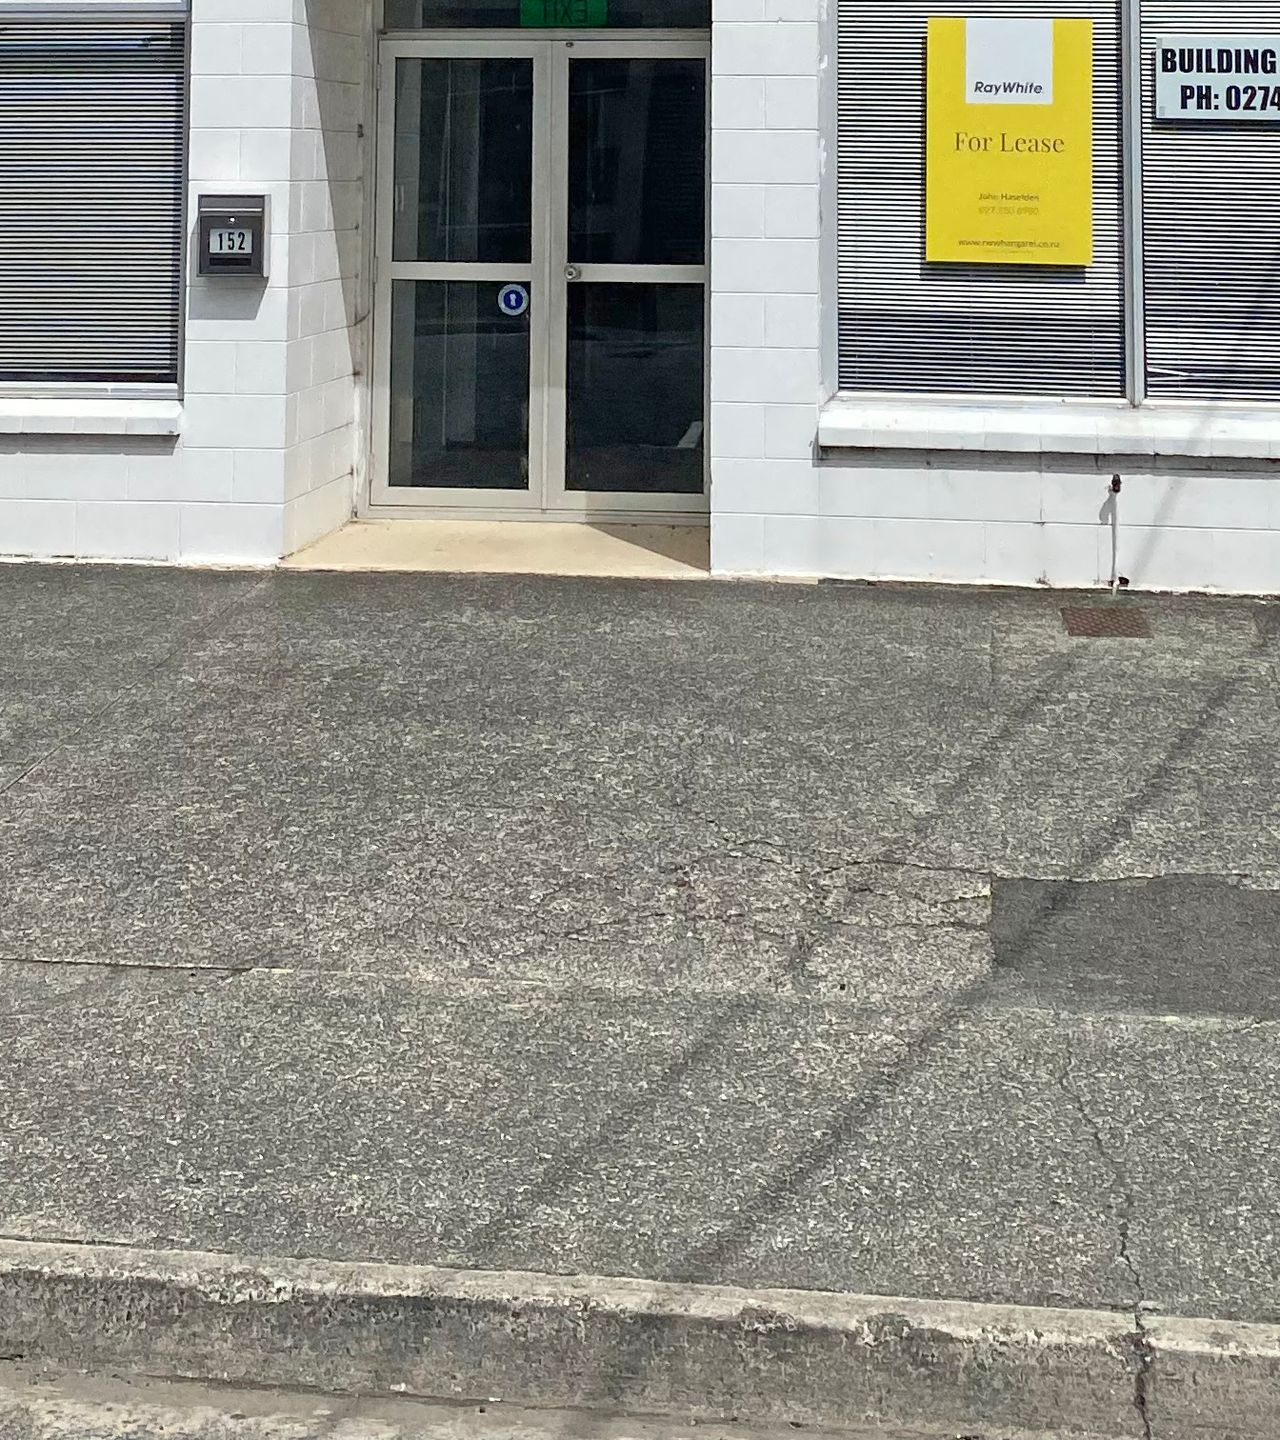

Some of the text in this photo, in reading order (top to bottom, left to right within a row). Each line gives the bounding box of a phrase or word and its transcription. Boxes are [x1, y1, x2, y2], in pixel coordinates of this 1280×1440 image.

[1161, 48, 1276, 74] BUILDING
[1180, 85, 1219, 110] PH:
[954, 131, 1065, 153] For Lease
[218, 231, 246, 251] 152
